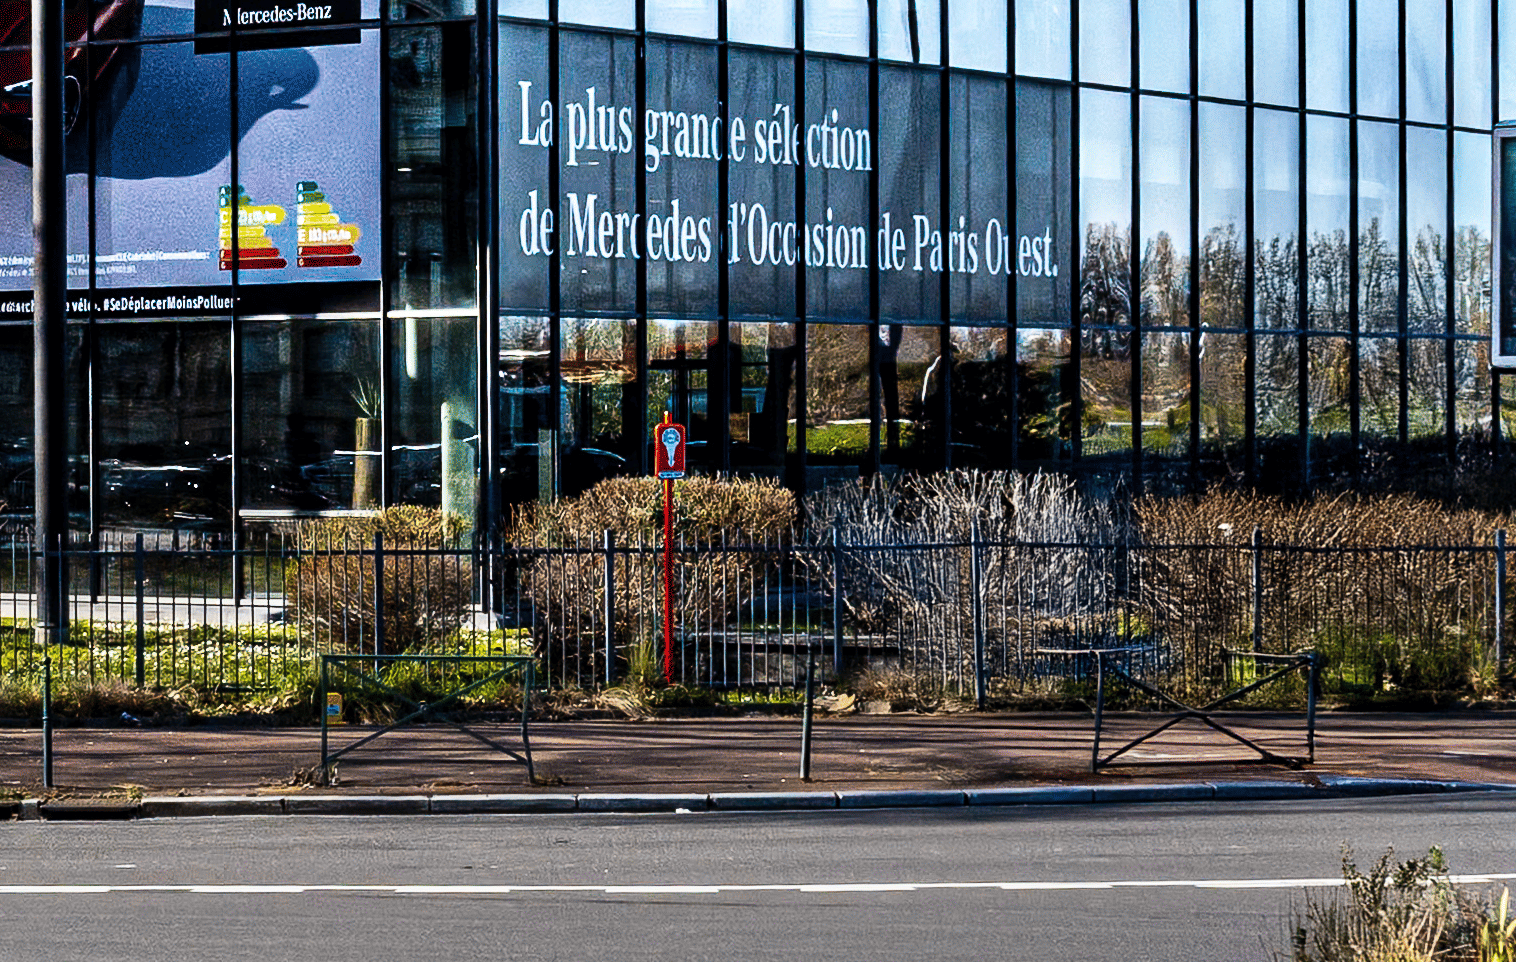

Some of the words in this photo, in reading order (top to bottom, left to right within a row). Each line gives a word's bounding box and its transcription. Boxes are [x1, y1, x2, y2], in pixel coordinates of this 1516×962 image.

[223, 3, 332, 26] Mercedes-Benz
[518, 81, 554, 148] La
[566, 86, 633, 167] plus
[520, 189, 555, 257] de
[567, 192, 712, 263] Mercedes
[878, 212, 906, 271] de
[913, 214, 979, 274] Paris
